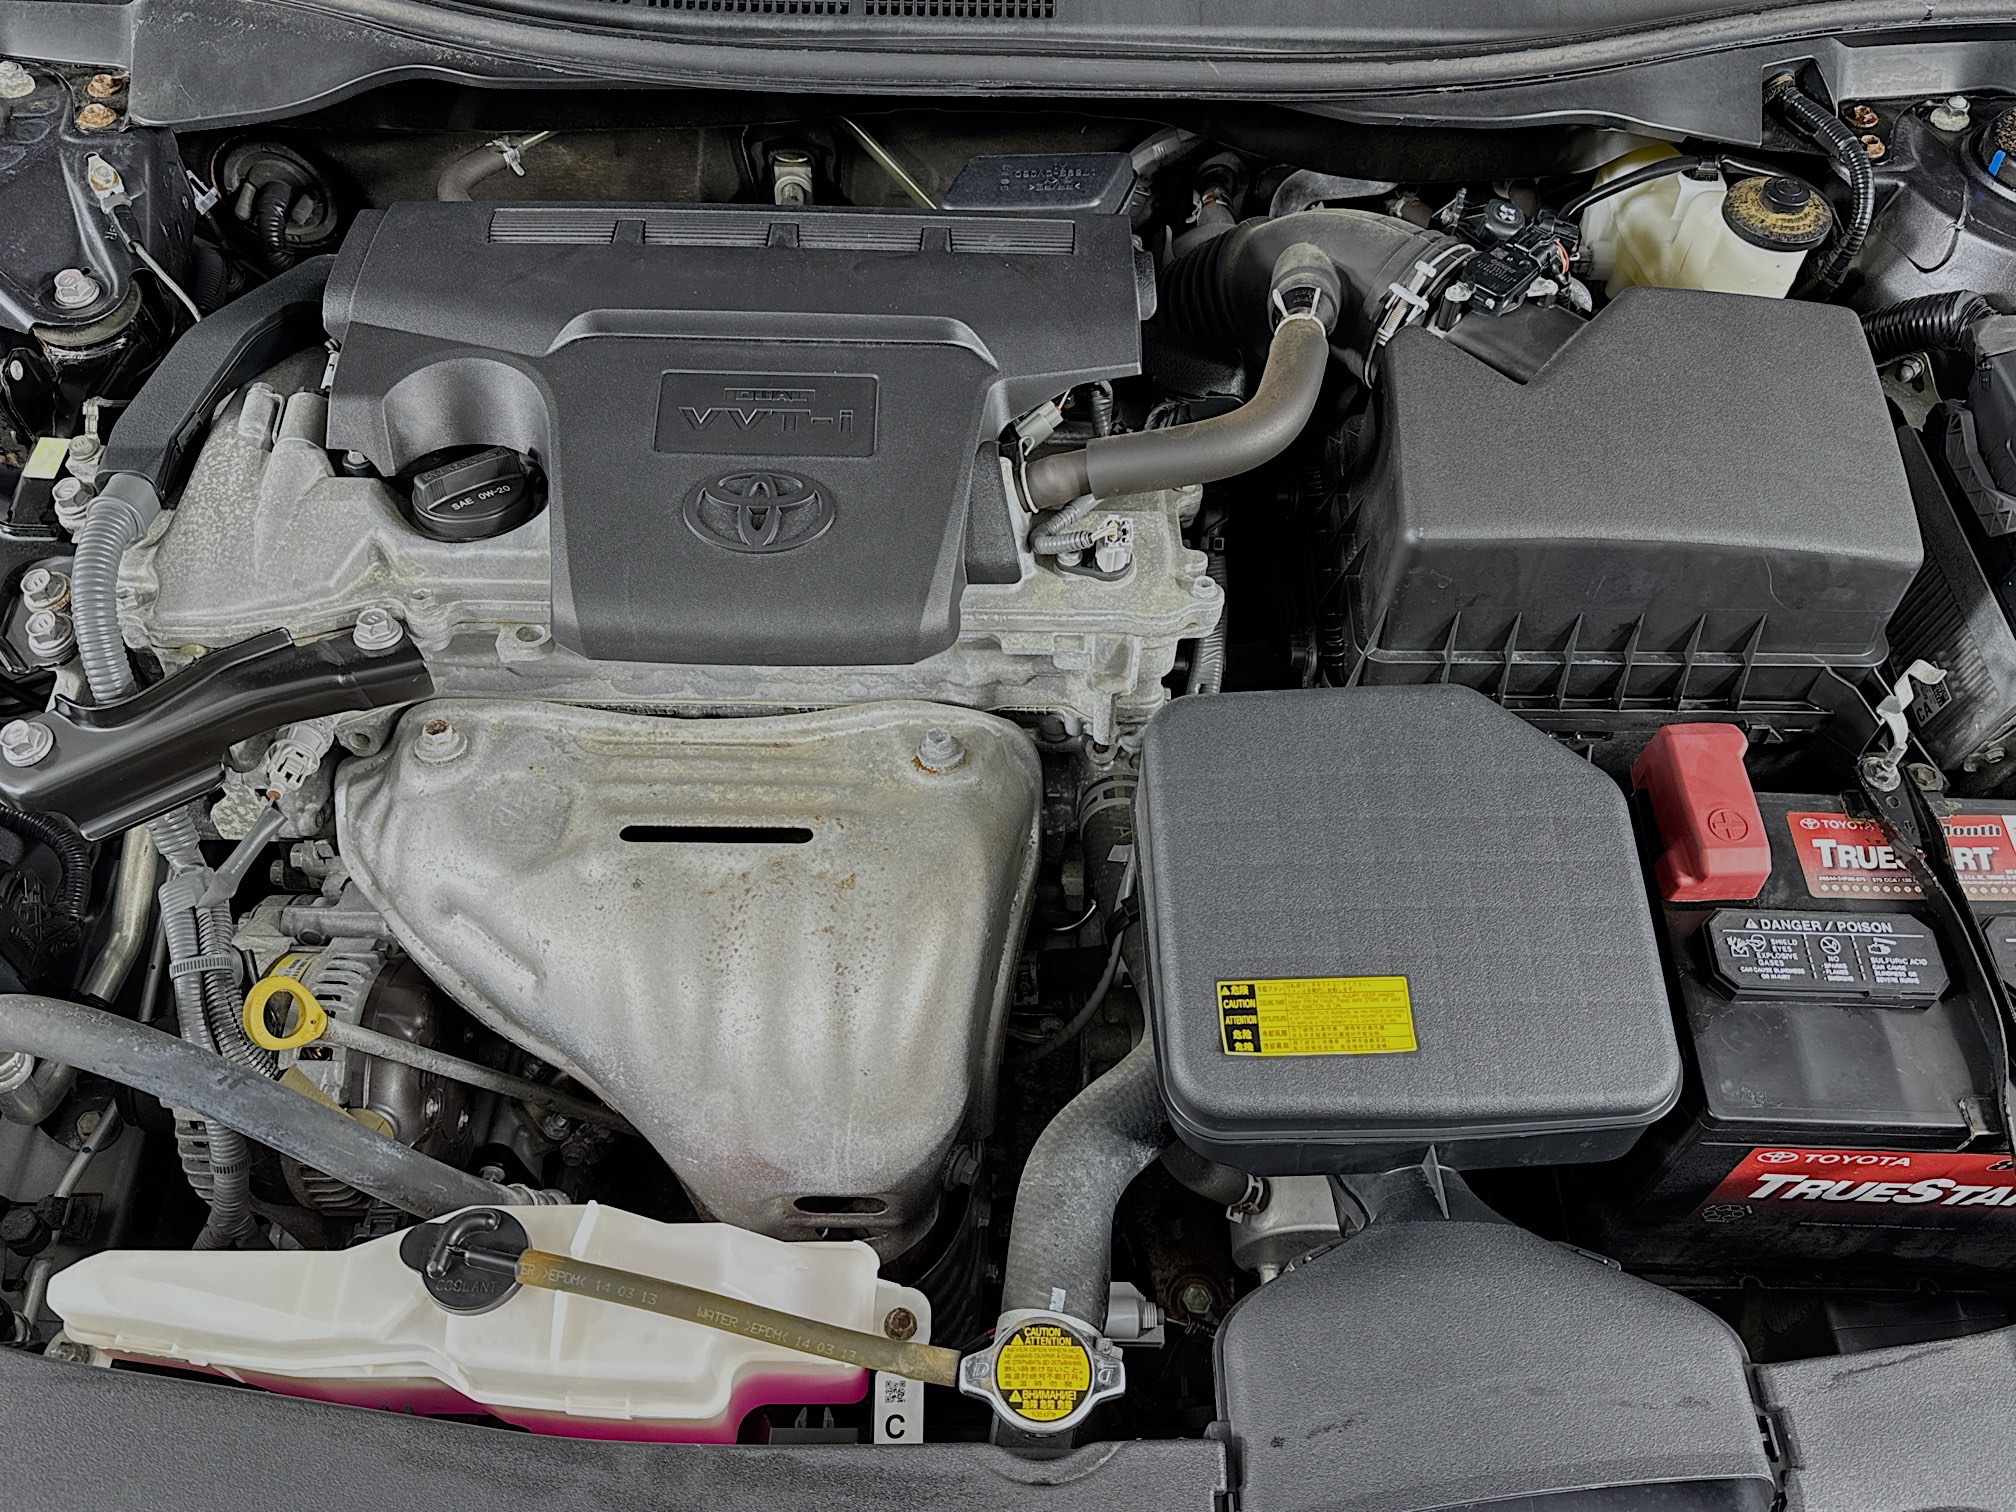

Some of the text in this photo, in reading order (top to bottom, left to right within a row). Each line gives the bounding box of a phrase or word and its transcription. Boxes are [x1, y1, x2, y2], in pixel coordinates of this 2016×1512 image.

[736, 389, 808, 402] DUAL
[678, 406, 854, 432] VVT-i
[451, 485, 511, 510] SAE 0W-20
[1761, 919, 1821, 932] DANGER
[1837, 921, 1893, 933] POISON
[1770, 938, 1798, 946] SHIELD
[1772, 945, 1793, 953] EYES
[1756, 952, 1799, 960] EXPLOSIVE
[1827, 955, 1840, 963] NO
[1758, 959, 1784, 967] GASES
[1870, 957, 1928, 966] SULFURIC ACID
[1223, 998, 1256, 1009] CAUTION
[1225, 1015, 1258, 1025] ATTENTION
[1804, 1153, 1911, 1167] TOYOTA
[435, 1278, 499, 1294] COOLANT
[595, 1278, 612, 1292] 14
[618, 1284, 634, 1299] 03
[641, 1291, 658, 1306] 13
[697, 1306, 857, 1362] WATER >EPDM< 14 03 13
[1024, 1327, 1061, 1337] CAUTION
[1024, 1337, 1072, 1346] ATTENTION
[1022, 1390, 1077, 1400] ВНИМАНИЕ!
[885, 1414, 906, 1439] C
